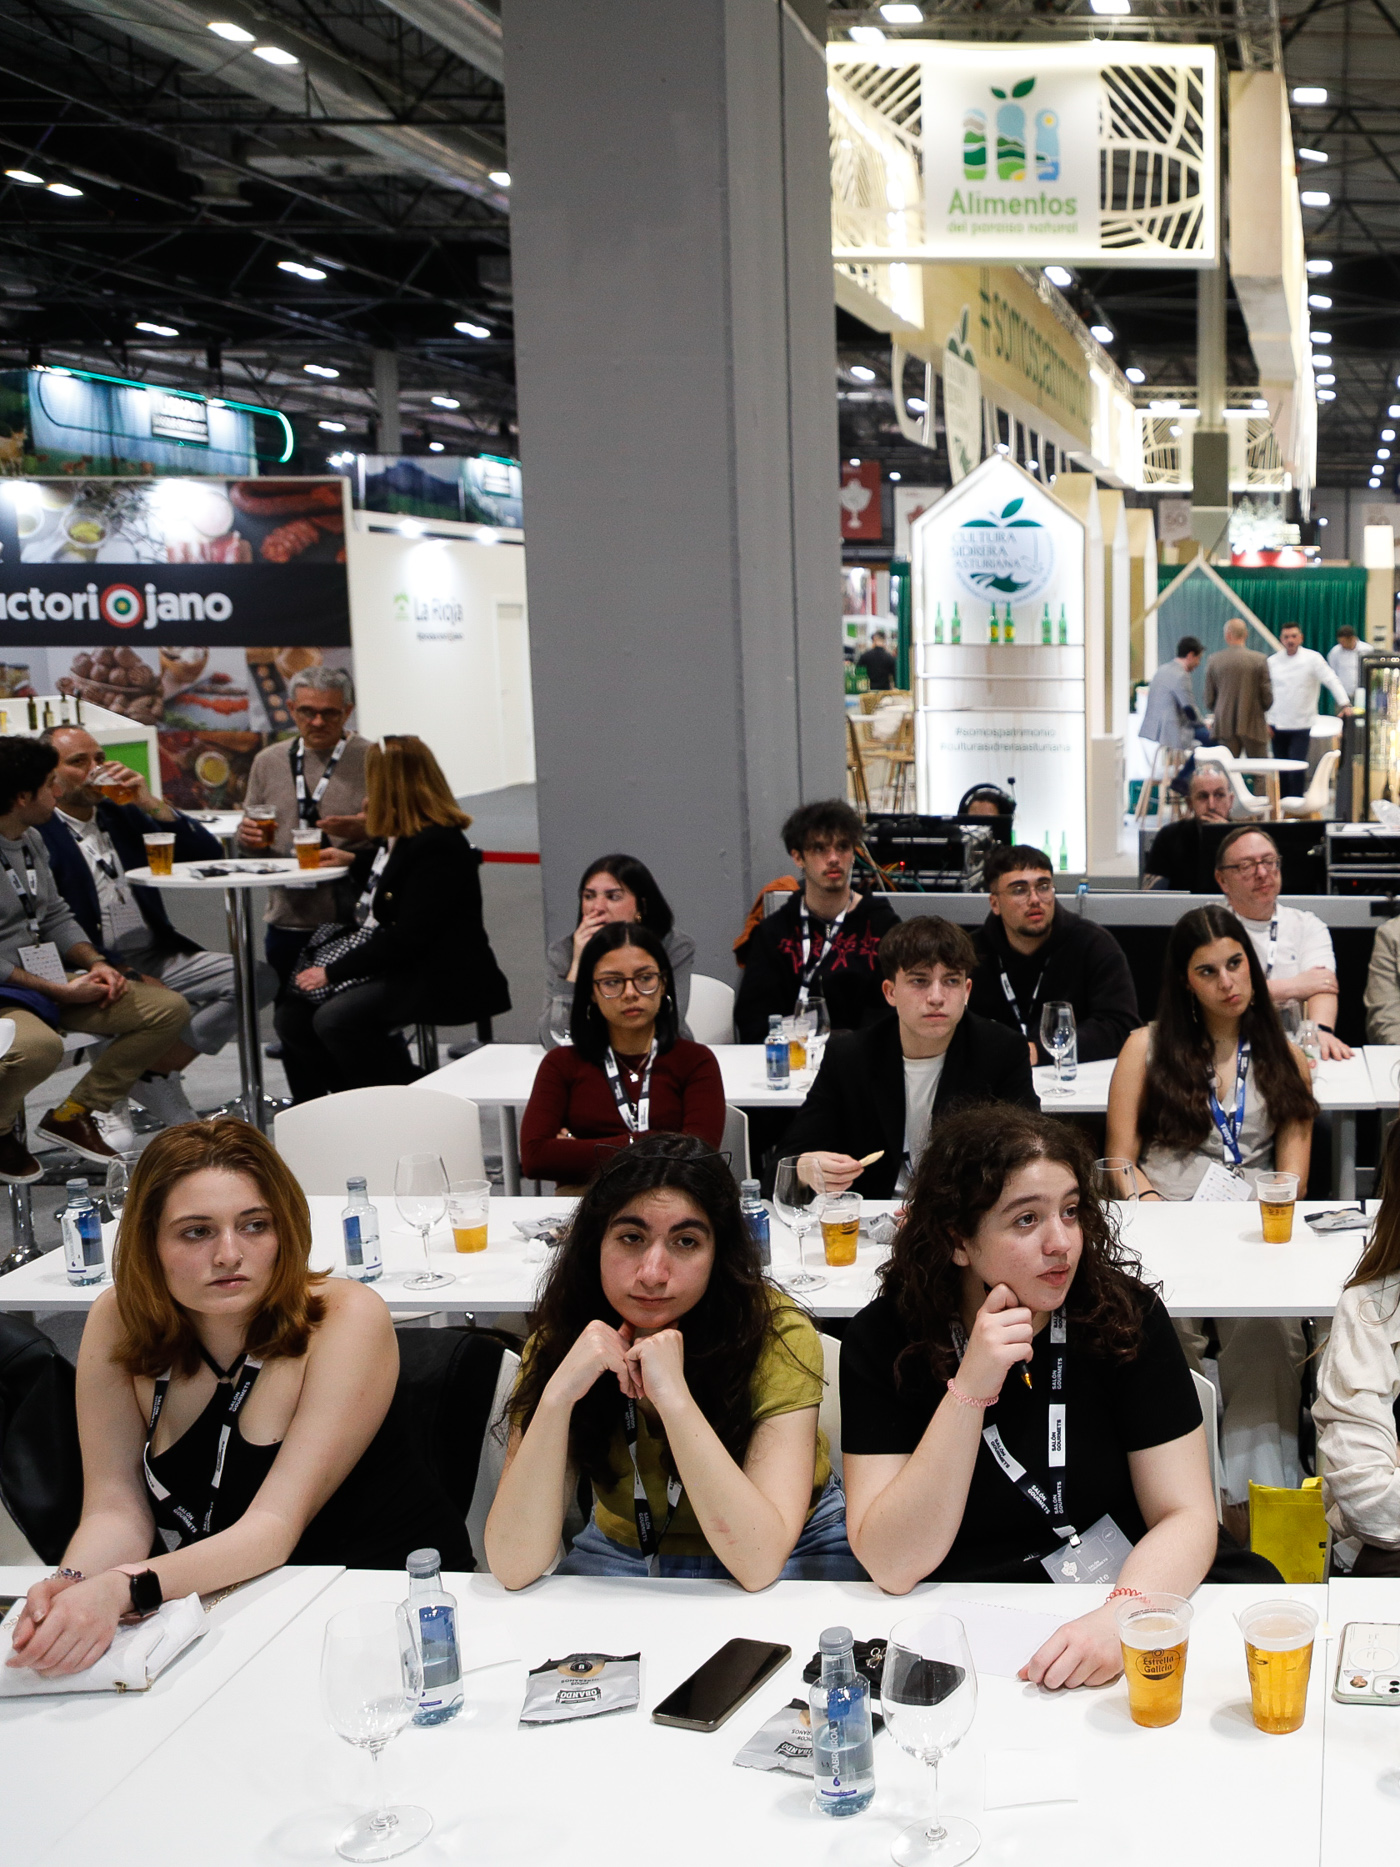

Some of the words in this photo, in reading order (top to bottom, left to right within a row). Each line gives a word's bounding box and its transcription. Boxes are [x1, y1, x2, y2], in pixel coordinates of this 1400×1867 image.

[949, 187, 1078, 216] Alimentos
[952, 531, 1017, 543] CULTURA
[952, 545, 1009, 557] SIDRERA
[955, 558, 1021, 569] ASTURIANA
[232, 1381, 251, 1412] GOURMETS
[990, 1440, 1011, 1469] GOURMETS
[994, 1438, 1007, 1457] SALÓN
[1027, 1488, 1051, 1515] GOURMETS
[1031, 1484, 1048, 1502] SALÓN
[1057, 1480, 1065, 1514] GOURMETS
[172, 1508, 198, 1533] GOURMETS
[178, 1505, 195, 1521] SALÓN
[638, 1512, 648, 1542] GOURMETS
[1142, 1656, 1174, 1666] Estrella
[1144, 1664, 1173, 1675] Galicia
[560, 1688, 598, 1699] OBANDO
